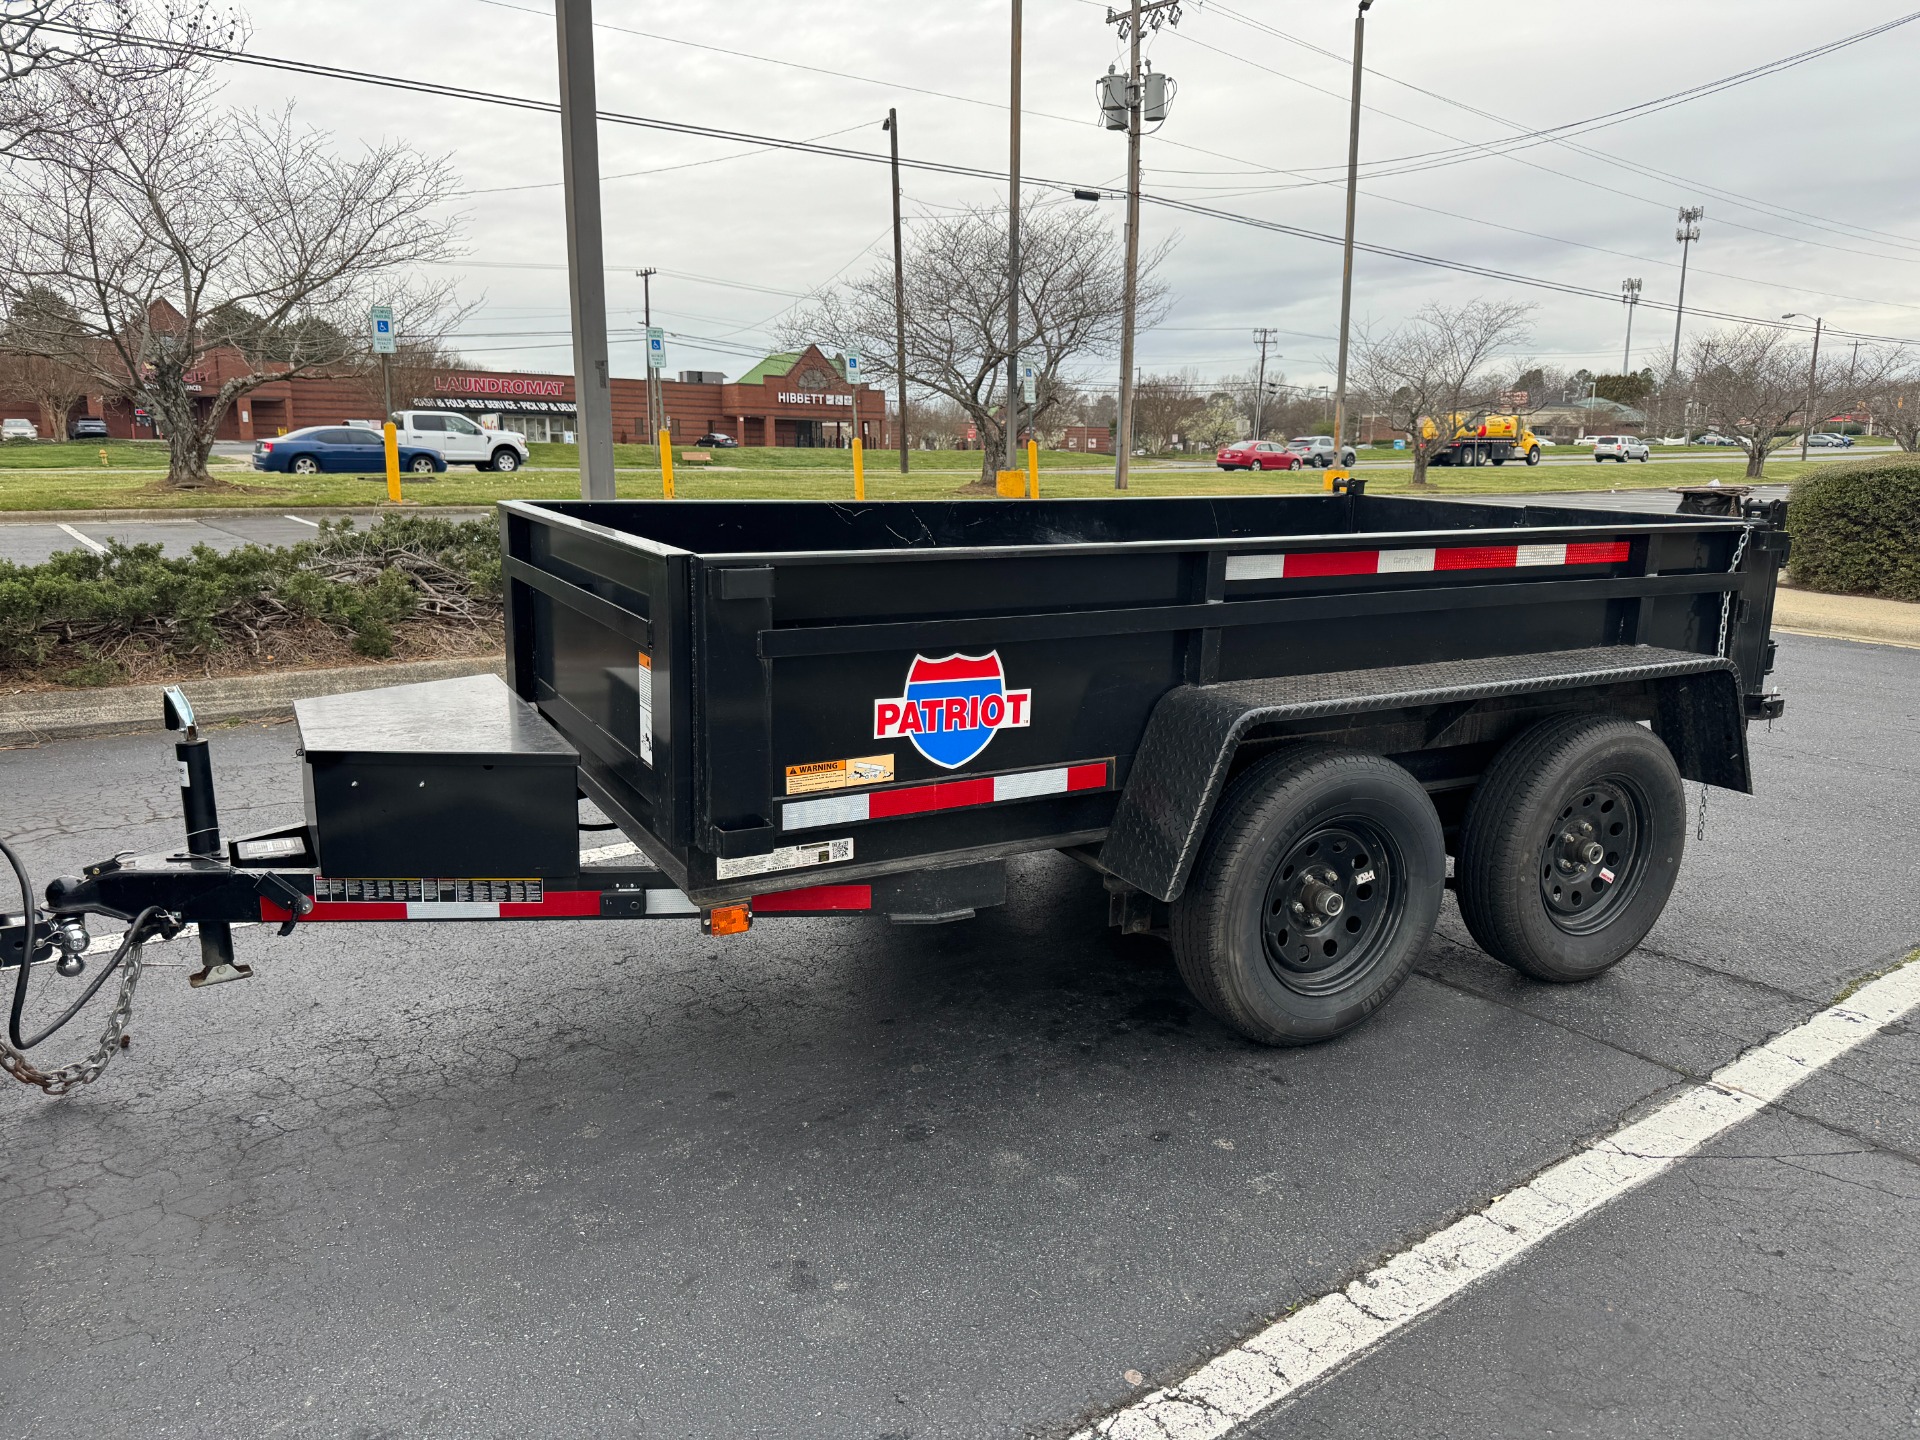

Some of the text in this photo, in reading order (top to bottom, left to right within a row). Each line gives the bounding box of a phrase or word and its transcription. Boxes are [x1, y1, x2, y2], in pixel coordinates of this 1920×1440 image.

[434, 376, 564, 395] LAUNDROMAT
[778, 392, 824, 405] HIBBETT
[486, 400, 516, 410] SERVICE
[521, 402, 538, 411] PICK
[537, 402, 549, 411] UP
[877, 693, 1028, 736] PATRIOT
[799, 762, 838, 773] WARNING
